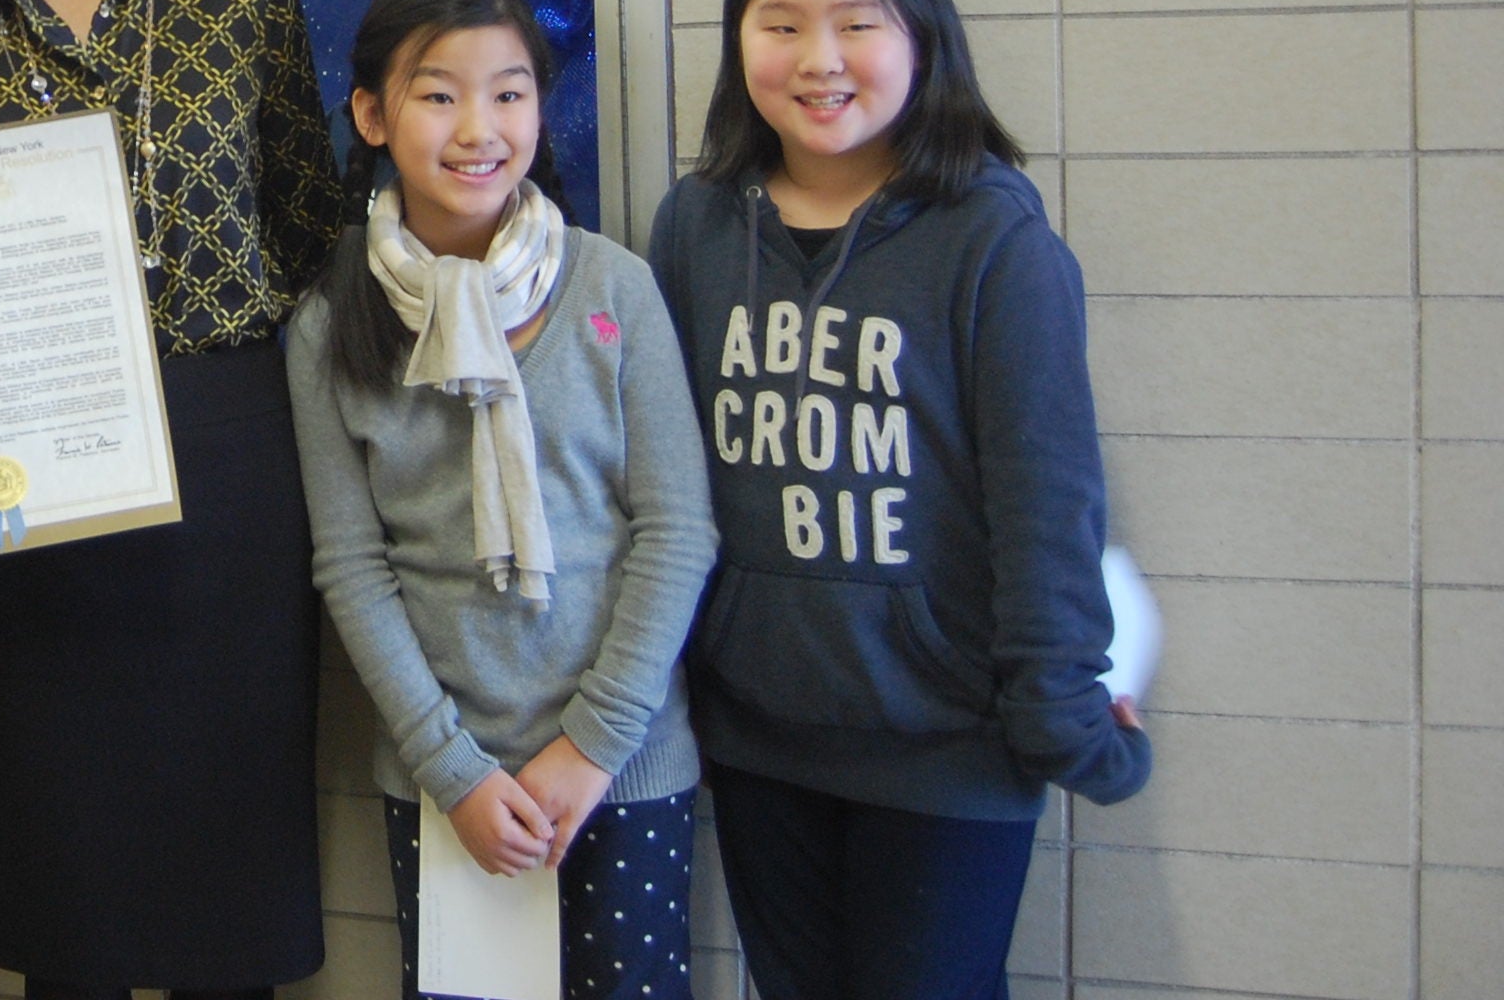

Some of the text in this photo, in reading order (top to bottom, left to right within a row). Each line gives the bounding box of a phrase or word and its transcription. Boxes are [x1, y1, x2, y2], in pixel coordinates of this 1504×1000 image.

[1, 149, 74, 170] Resolution
[19, 139, 45, 152] York
[720, 300, 902, 397] ABER
[713, 389, 912, 477] CROM
[782, 484, 910, 564] BIE
